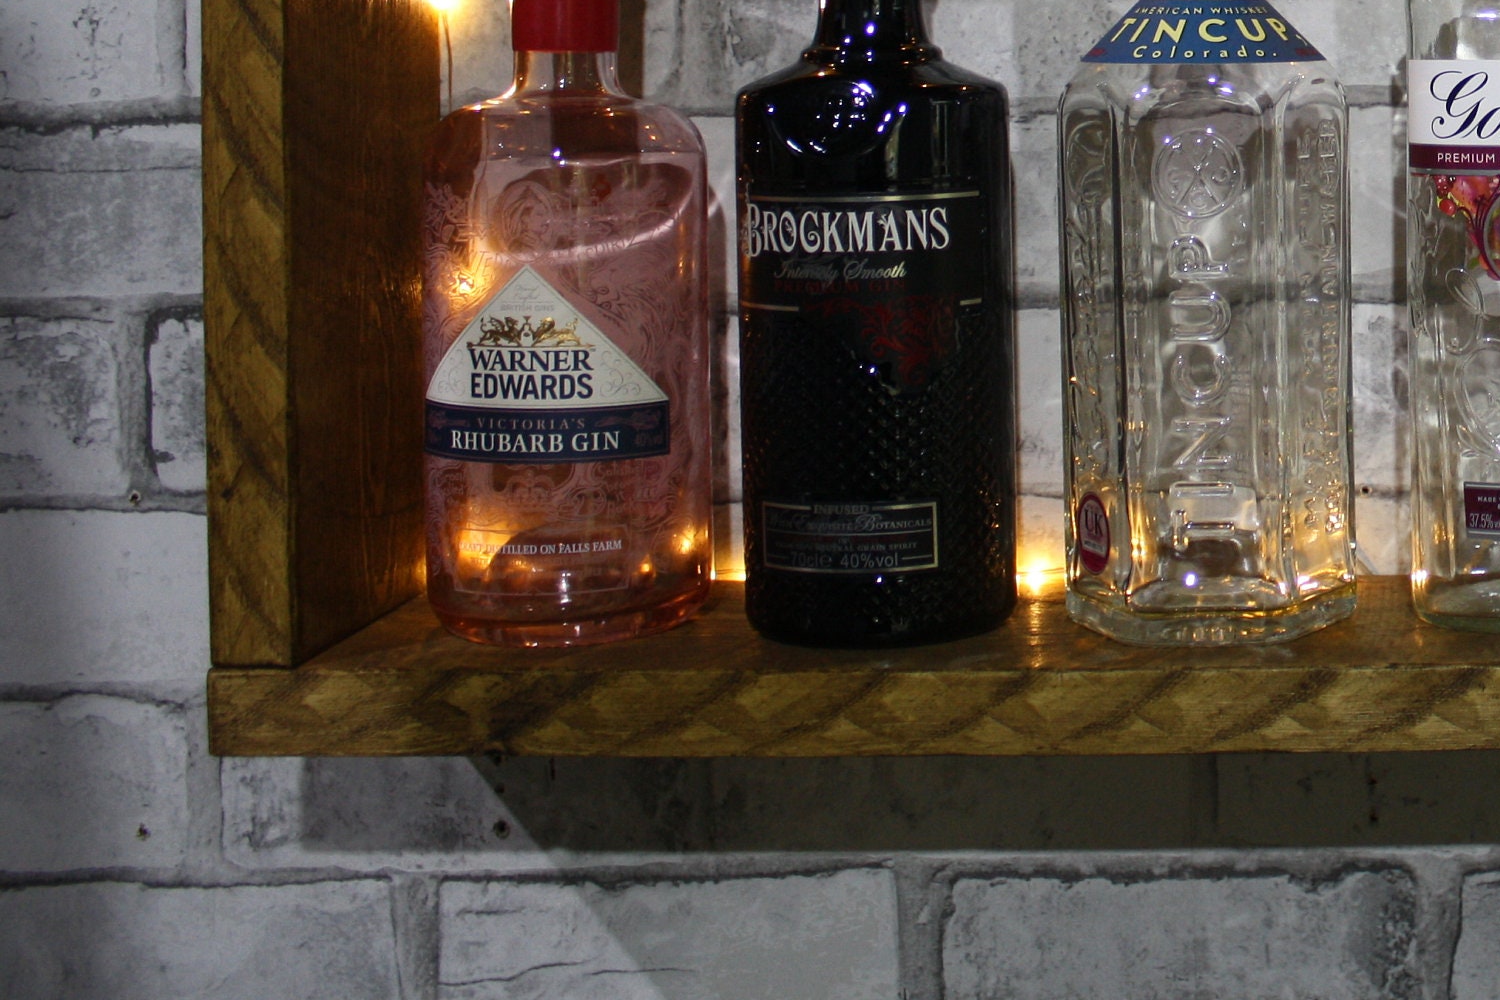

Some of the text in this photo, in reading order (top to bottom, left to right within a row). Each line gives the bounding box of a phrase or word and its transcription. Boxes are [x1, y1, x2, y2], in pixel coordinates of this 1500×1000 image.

[1135, 6, 1204, 15] AMERICAN
[1110, 17, 1289, 43] TINCUP
[1437, 152, 1496, 164] PREMIUM
[746, 203, 950, 258] BROCKMANS
[842, 258, 907, 280] Smooth
[468, 349, 595, 373] WARNER
[470, 372, 594, 400] EDWARDS
[1169, 233, 1236, 551] TINCUP
[476, 417, 586, 431] VICTORIA'S
[451, 430, 564, 453] RHUBARB
[571, 431, 621, 452] GIN
[813, 504, 870, 515] INFUSED
[1477, 495, 1497, 503] MADE
[485, 543, 537, 555] DISTILLED
[539, 544, 557, 555] ON
[559, 542, 591, 554] FALLS
[593, 539, 622, 552] FARM
